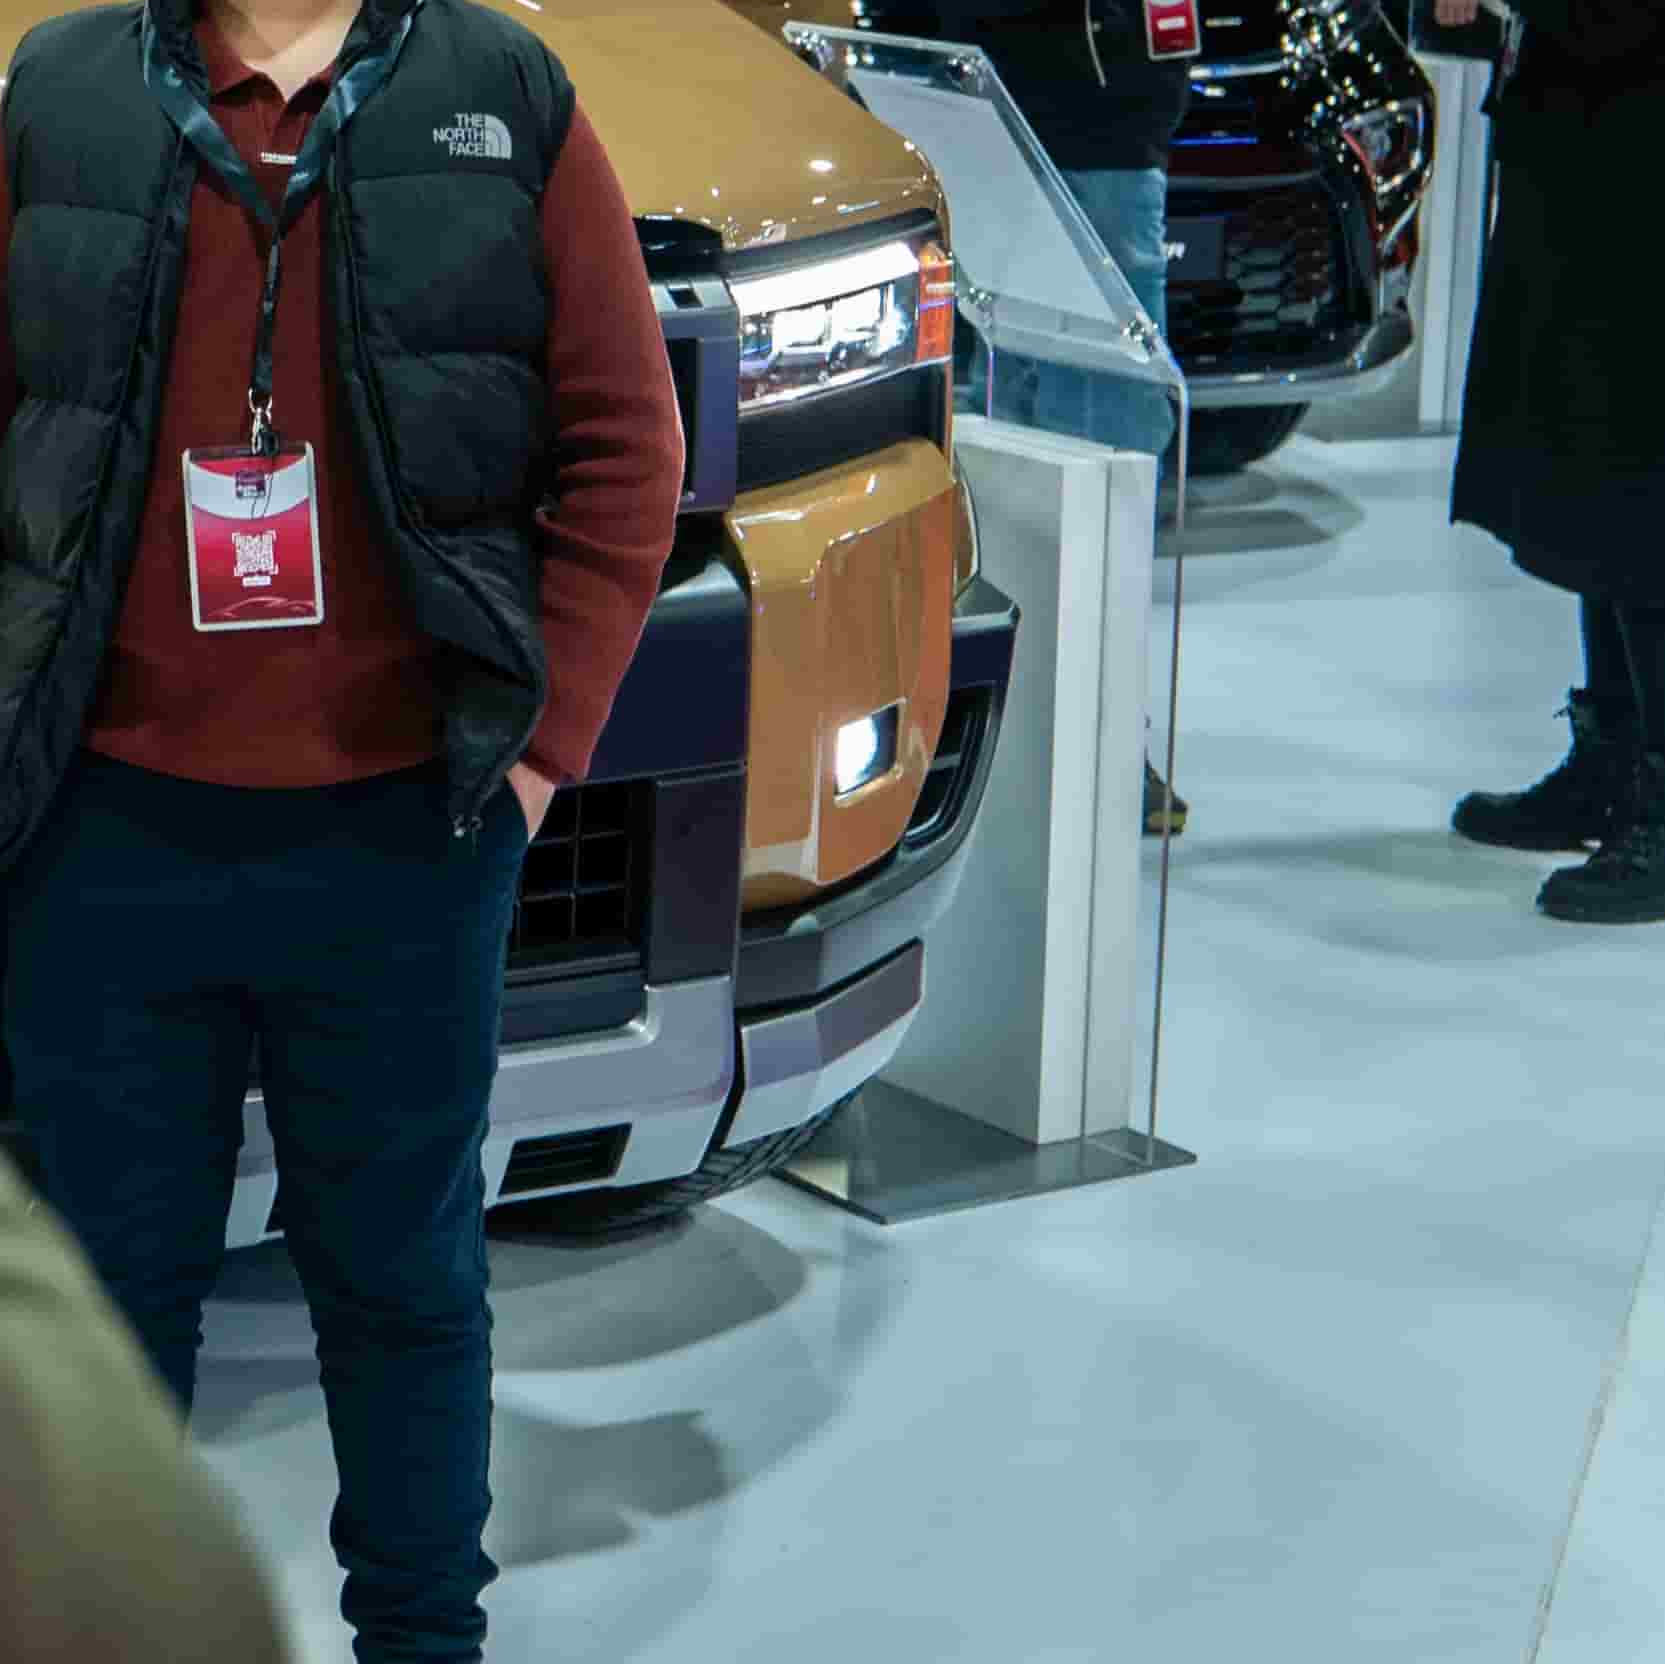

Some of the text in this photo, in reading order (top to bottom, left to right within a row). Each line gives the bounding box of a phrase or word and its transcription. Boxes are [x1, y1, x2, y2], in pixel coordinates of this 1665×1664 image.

[455, 112, 484, 128] THE
[433, 127, 484, 145] NORTH
[448, 143, 484, 158] FACE
